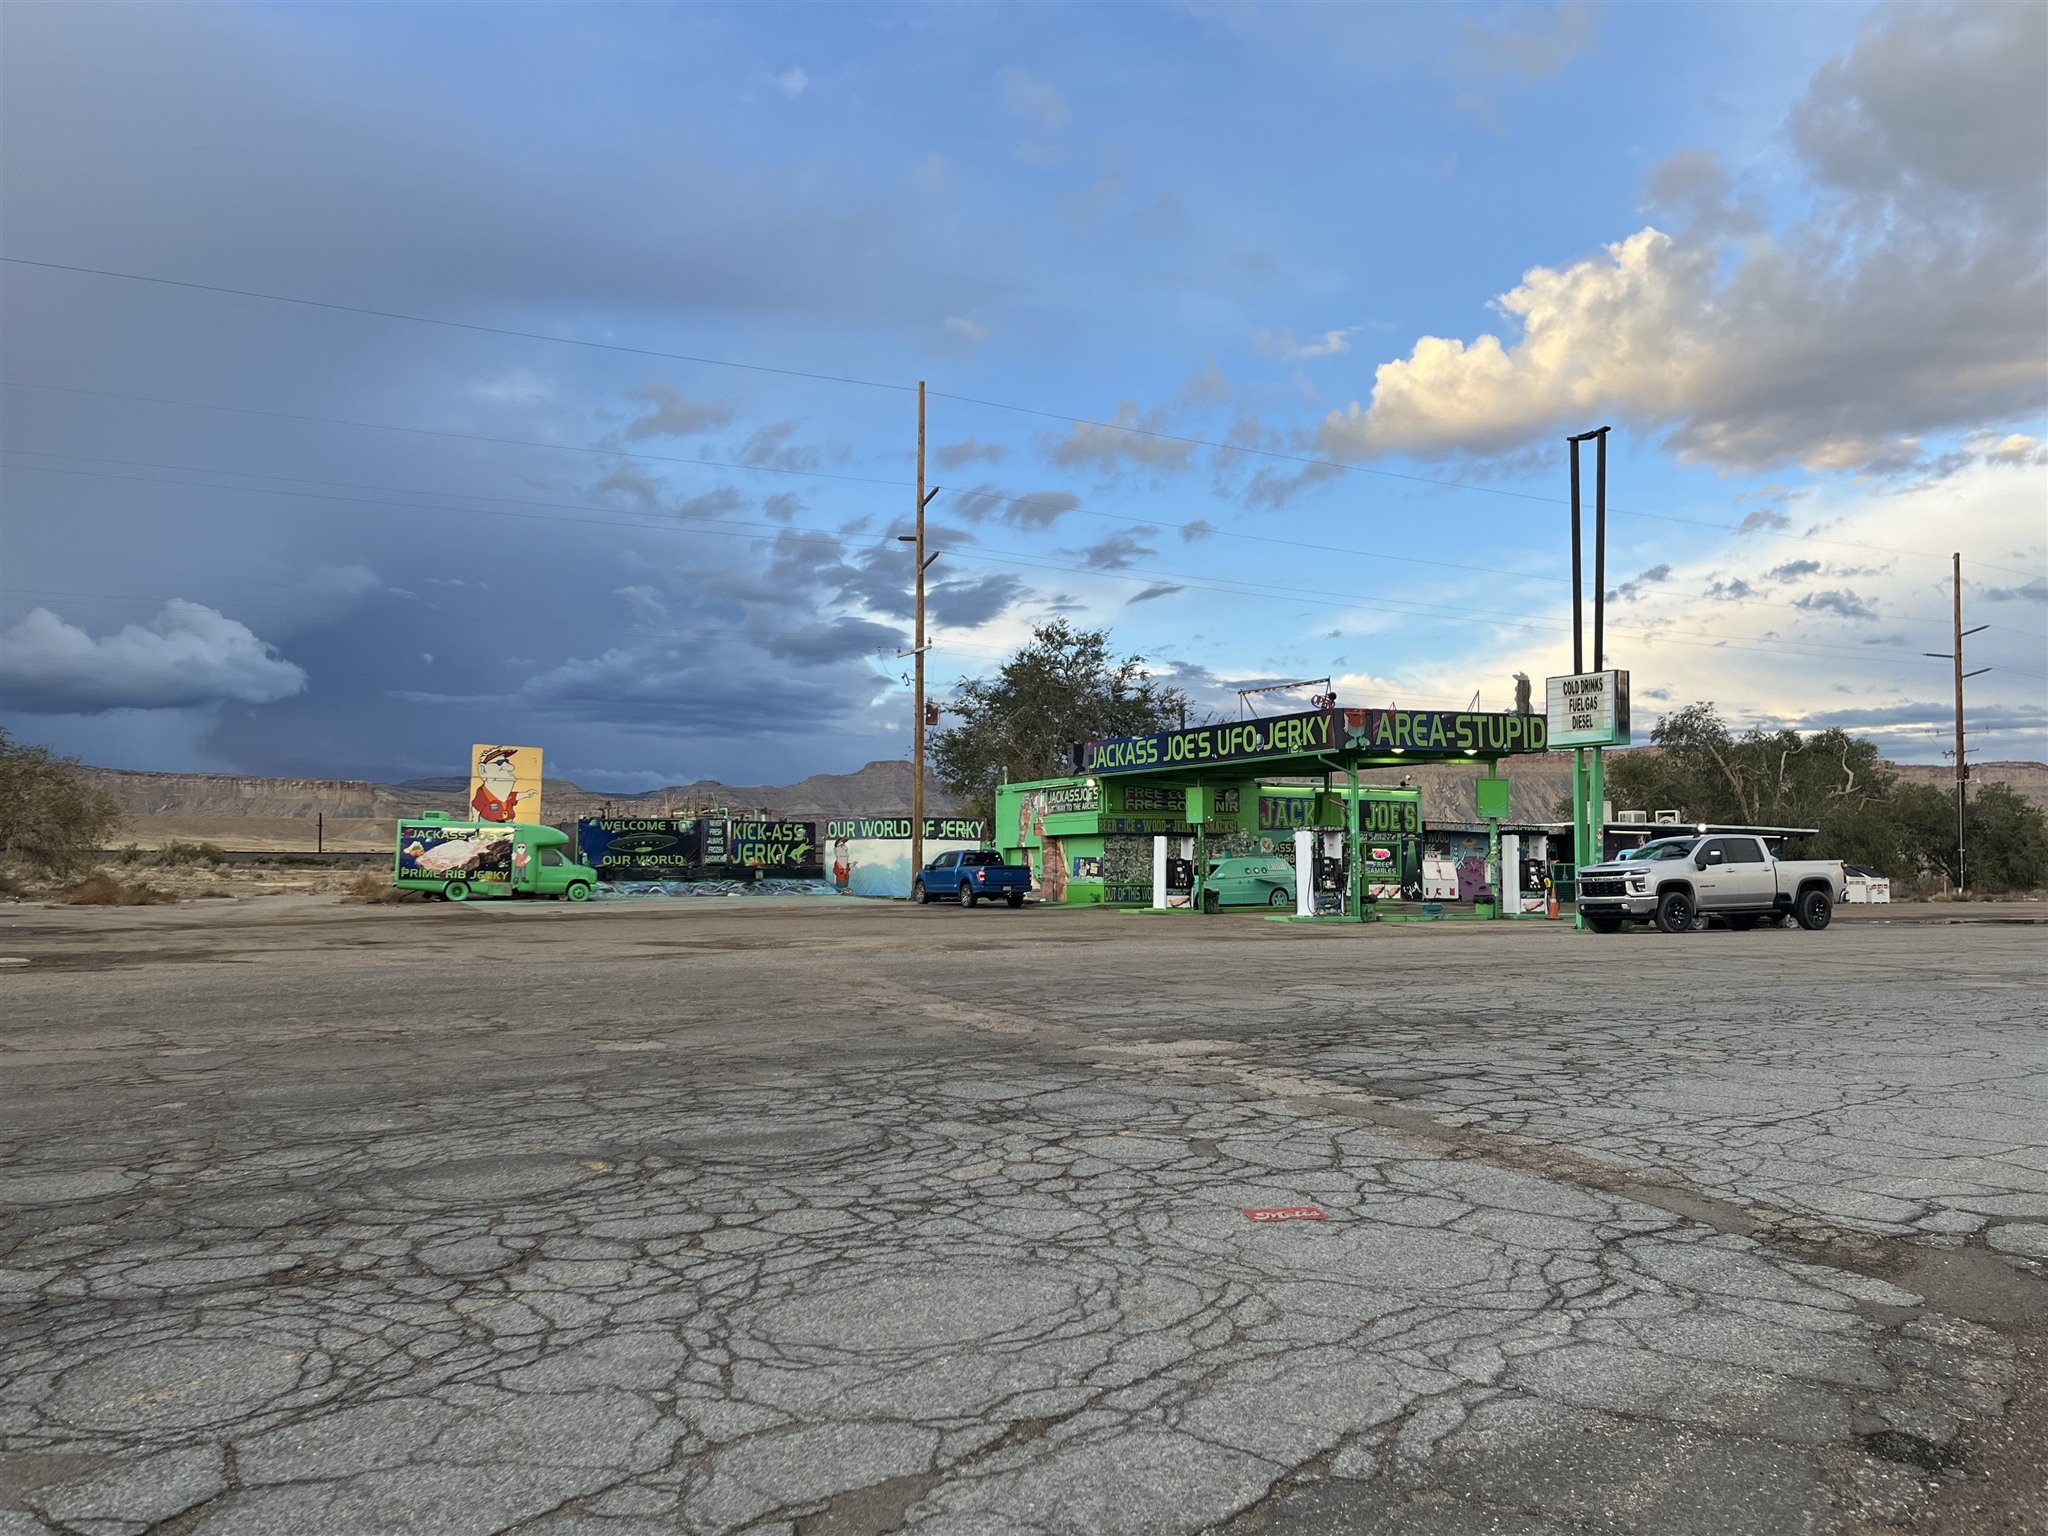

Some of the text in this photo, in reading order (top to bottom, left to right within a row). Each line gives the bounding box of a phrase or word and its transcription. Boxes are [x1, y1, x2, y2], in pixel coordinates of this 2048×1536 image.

[1563, 677, 1603, 696] COLD DRINKS
[1572, 713, 1593, 730] DIESEL
[1089, 714, 1332, 769] JACKASS JOE'S UFO JERKY
[1125, 786, 1163, 799] FREE
[1125, 799, 1239, 812] FREE SONIR
[1261, 798, 1416, 831] JACK JOE'S
[599, 820, 666, 831] WELCOME
[733, 822, 804, 841] KICK-ASS
[827, 820, 856, 838] OUR
[860, 820, 911, 838] WORLD
[938, 820, 985, 838] JERKY
[1098, 819, 1117, 832] BEER
[1124, 819, 1136, 832] ICE
[1142, 819, 1166, 832] WOOD
[1172, 820, 1197, 833] JERKY
[410, 829, 467, 840] JACKASS
[1428, 833, 1450, 843] WOOD
[602, 854, 684, 865] OUR WORLD
[732, 843, 789, 865] JERKY
[401, 868, 509, 880] PRIME RIB JERKY
[1105, 887, 1117, 900] OUT
[1118, 887, 1126, 900] OF
[1127, 886, 1141, 901] THIS
